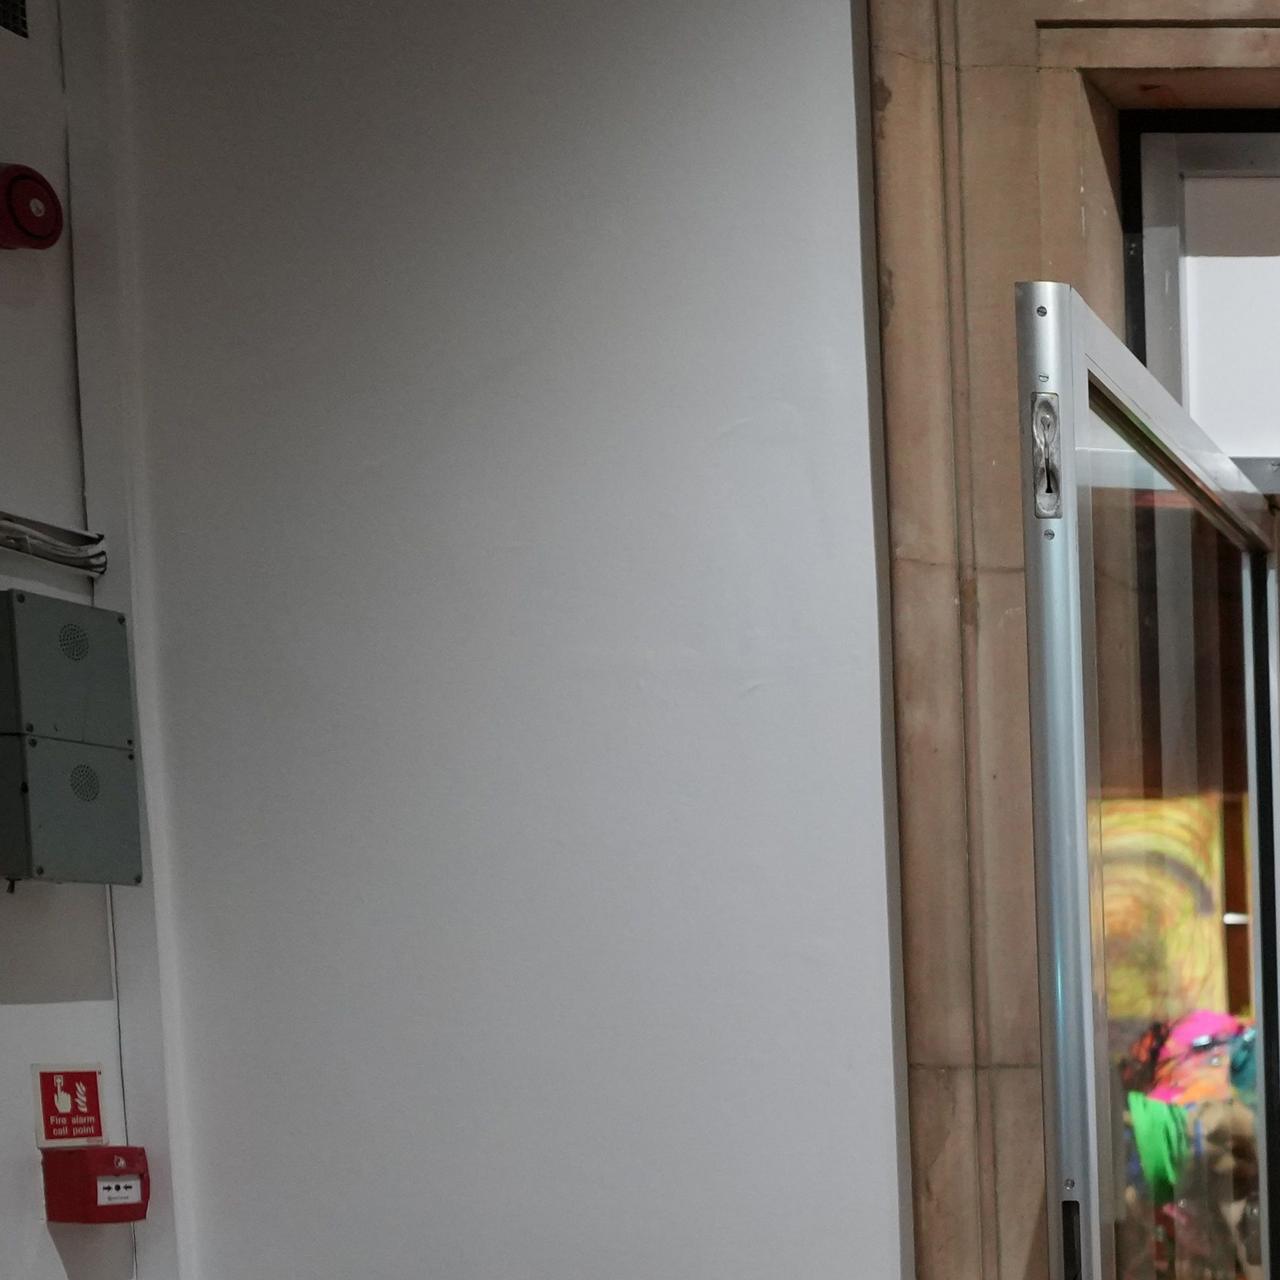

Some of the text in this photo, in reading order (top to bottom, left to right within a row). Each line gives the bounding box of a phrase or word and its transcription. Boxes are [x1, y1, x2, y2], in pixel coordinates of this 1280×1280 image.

[50, 1115, 96, 1125] Fire alarm
[52, 1125, 95, 1137] call point
